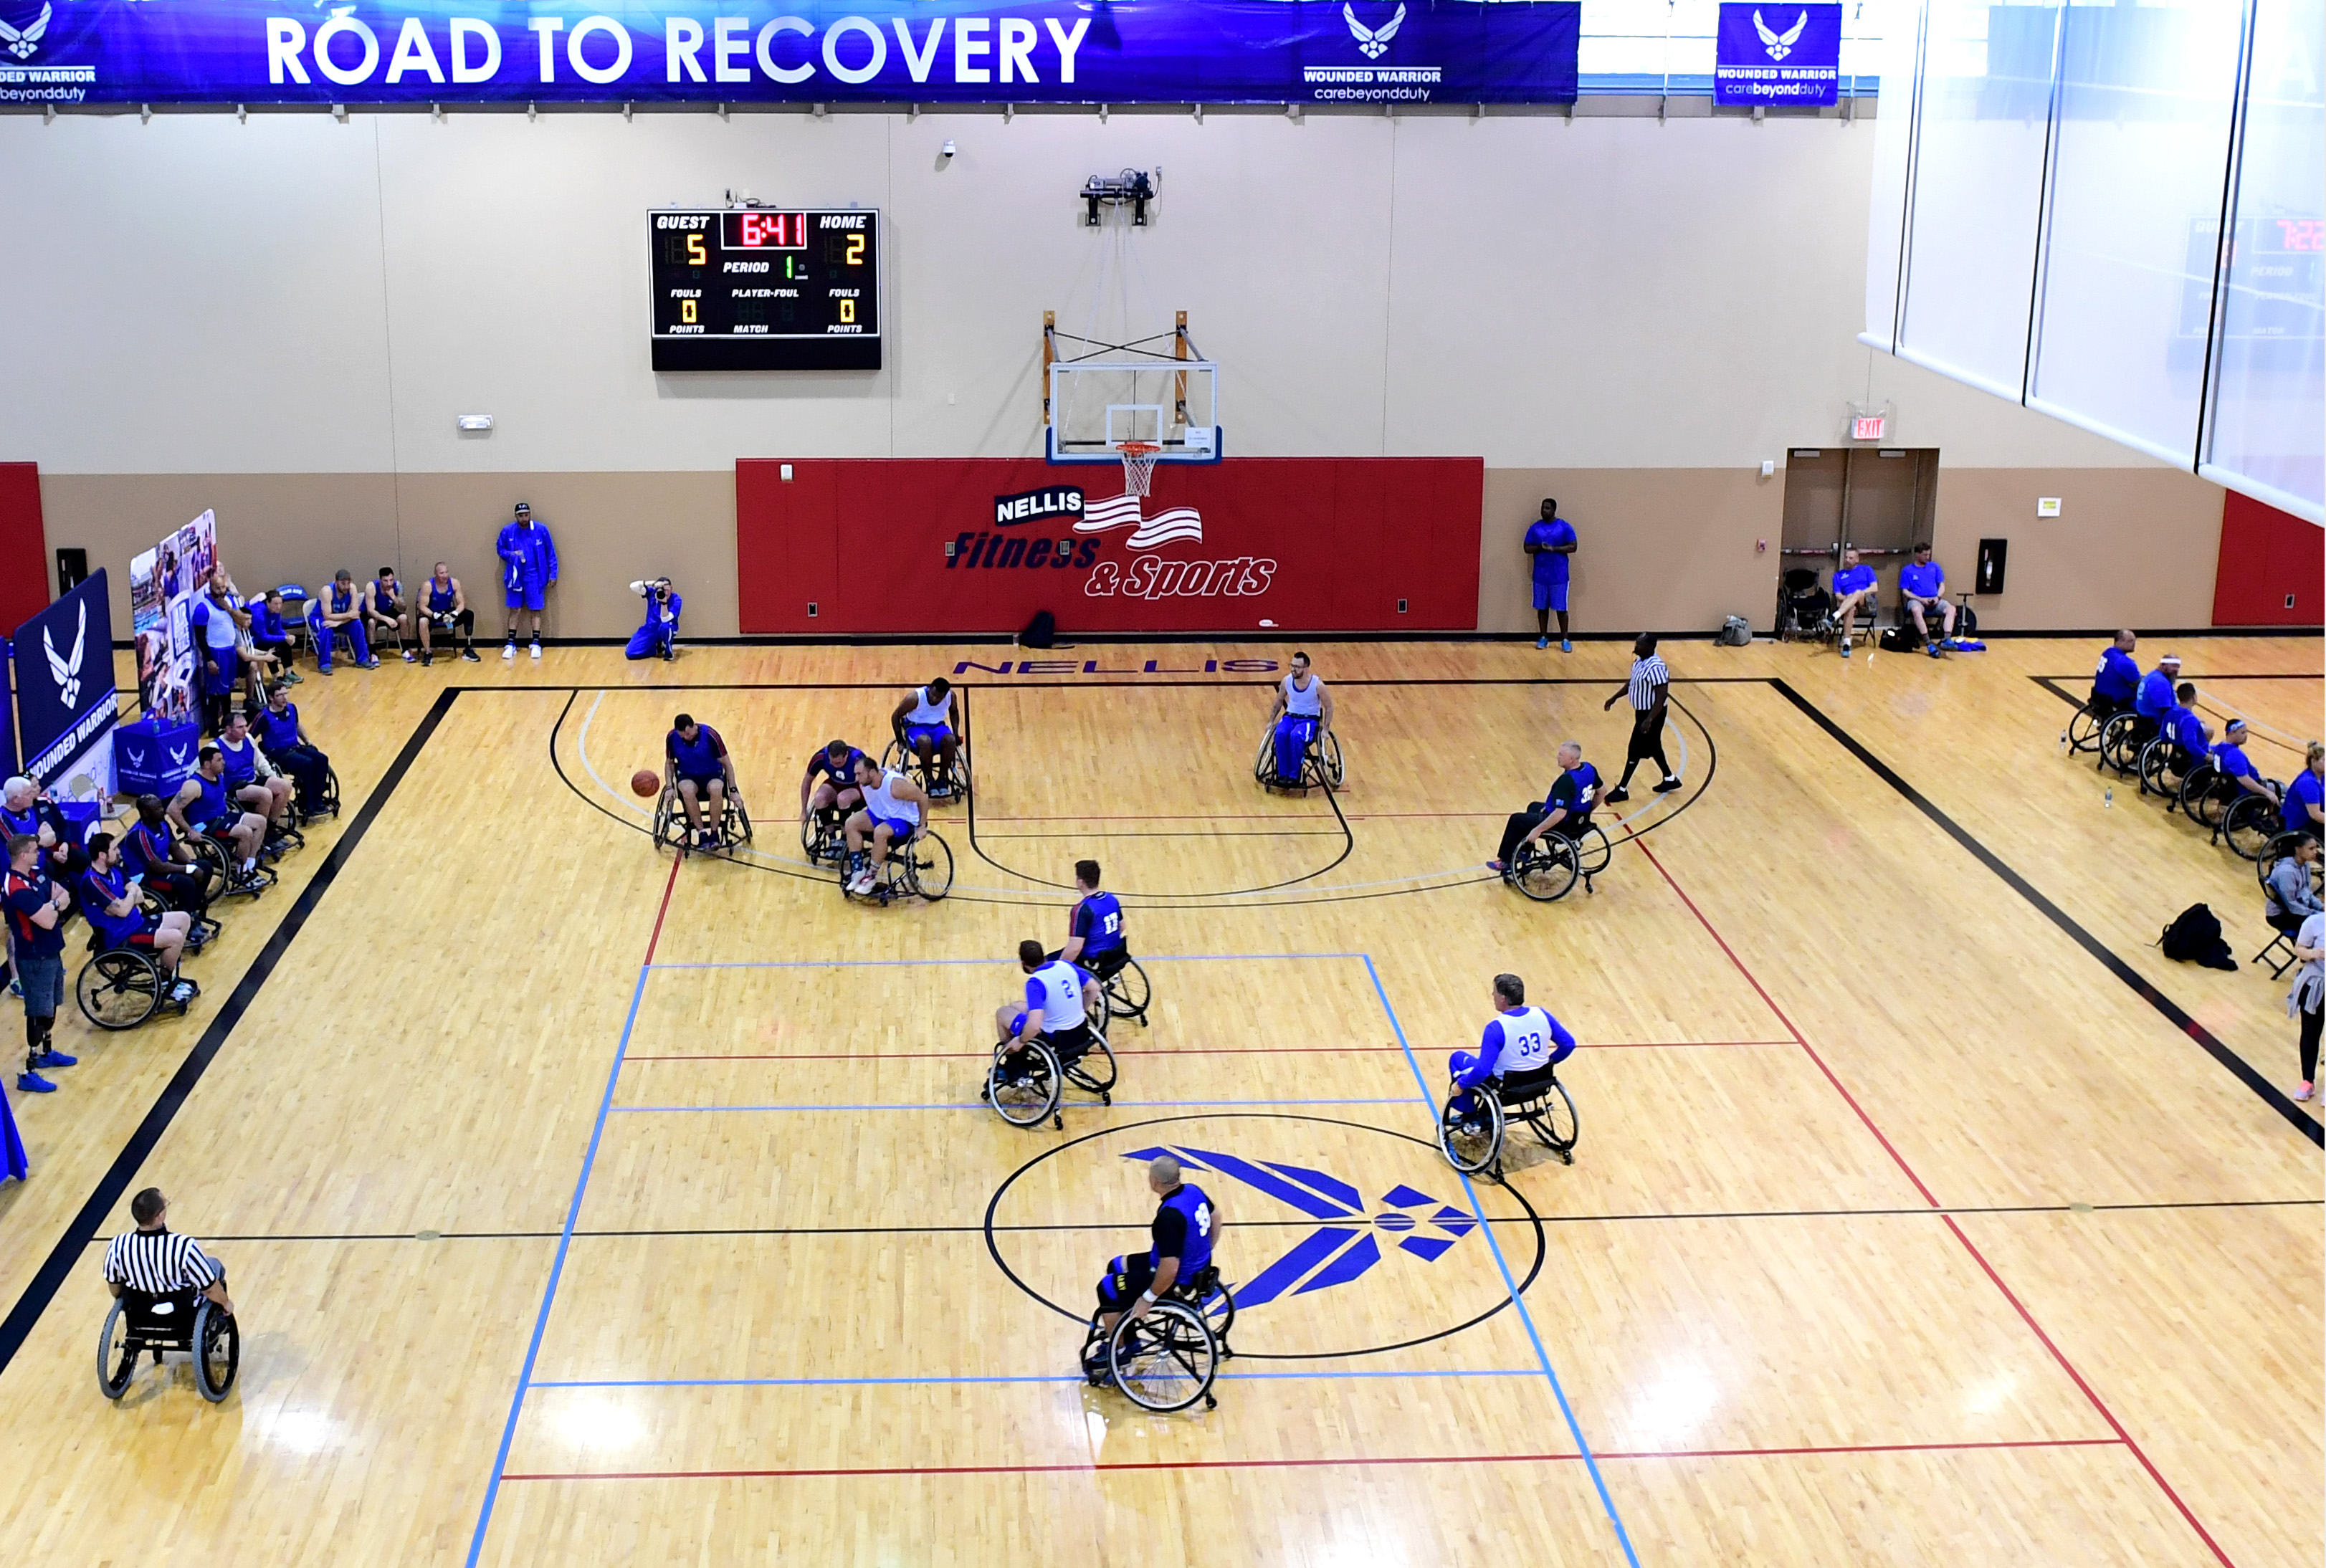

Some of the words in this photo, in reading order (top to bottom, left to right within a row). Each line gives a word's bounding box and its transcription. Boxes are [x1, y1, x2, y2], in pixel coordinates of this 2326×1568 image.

[266, 16, 502, 85] ROAD
[528, 16, 633, 85] TO
[667, 16, 1091, 84] RECOVERY
[29, 71, 96, 82] WARRIOR
[1304, 72, 1373, 82] WOUNDED
[1377, 72, 1441, 82] WARRIOR
[1717, 69, 1778, 79] WOUNDED
[1781, 70, 1836, 80] WARRIOR
[1315, 87, 1430, 102] carebeyondduty
[1725, 82, 1826, 98] carebeyondduty
[657, 216, 710, 229] GUEST
[742, 214, 804, 246] 6:41
[819, 216, 867, 229] HOME
[687, 234, 707, 265] 5
[846, 234, 865, 265] 2
[723, 262, 770, 274] PERIOD
[671, 289, 702, 298] FOULS
[829, 288, 860, 298] FOULS
[682, 300, 697, 322] 0
[840, 299, 854, 322] 0
[669, 325, 705, 334] POINTS
[733, 325, 769, 334] MATCH
[827, 325, 863, 334] POINTS
[1857, 419, 1882, 436] EXIT
[997, 492, 1082, 522] NELLIS
[945, 532, 1101, 569] Fitness
[1084, 561, 1120, 596] &
[1122, 555, 1277, 600] Sports
[953, 659, 1279, 674] NELLIS
[77, 693, 118, 743] WARRIOR
[1519, 1032, 1541, 1056] 33
